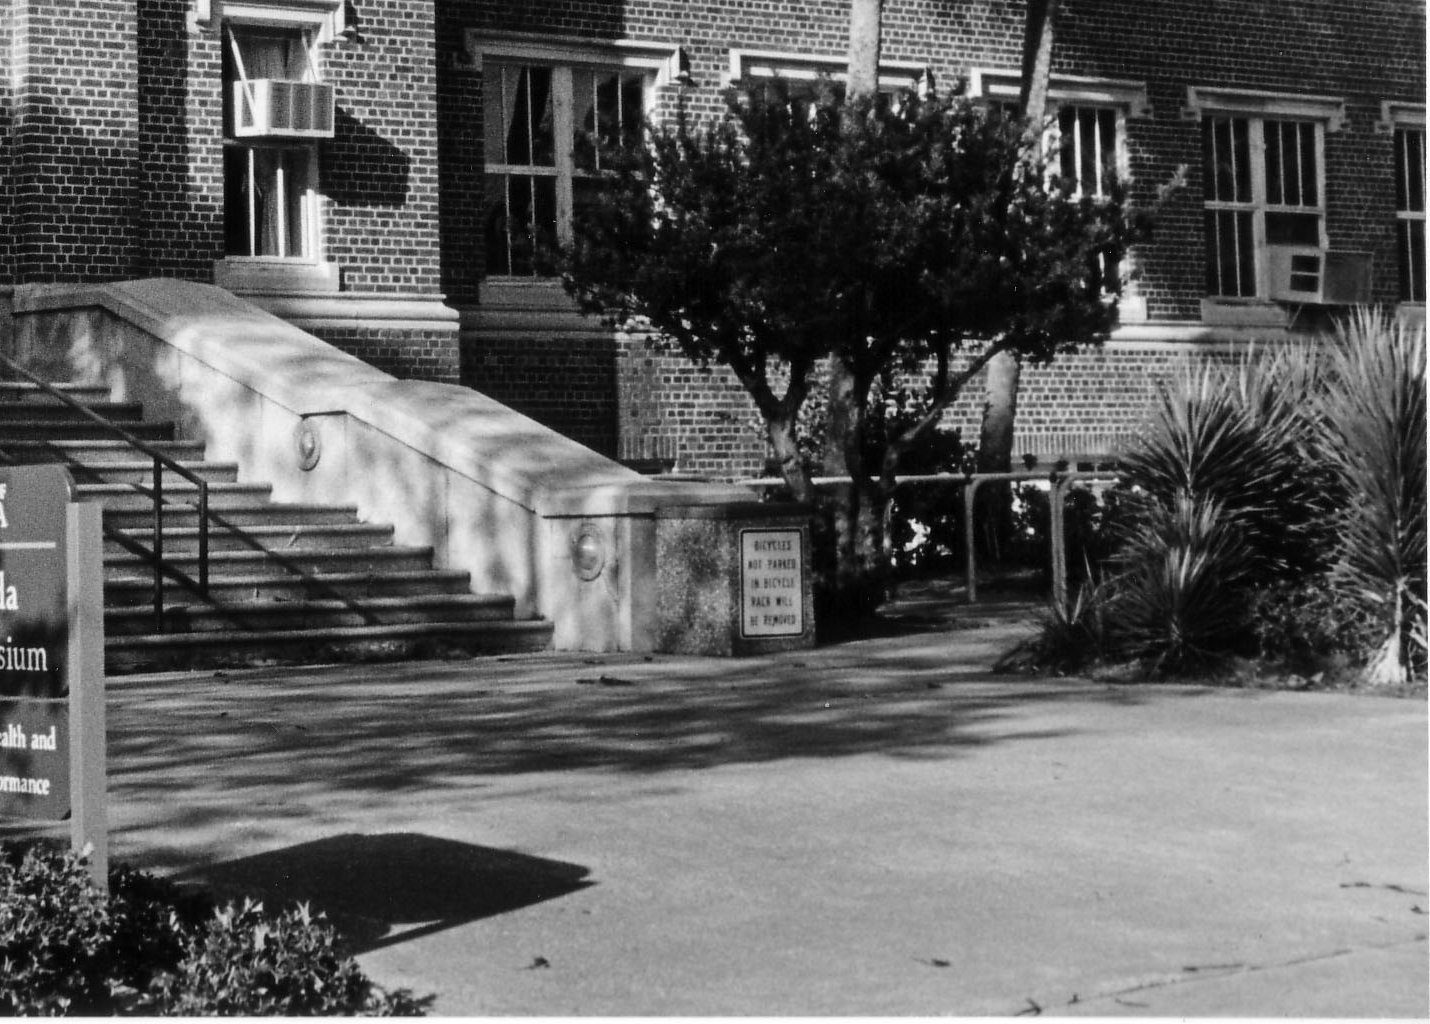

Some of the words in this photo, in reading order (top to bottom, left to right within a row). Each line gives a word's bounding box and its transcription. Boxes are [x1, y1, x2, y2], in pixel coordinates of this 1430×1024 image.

[754, 540, 792, 551] BICYCLES
[748, 559, 762, 570] NOT
[767, 558, 796, 570] PARKED
[751, 577, 759, 589] IN
[763, 577, 794, 589] BICYCLE
[751, 596, 770, 607] RACK
[750, 615, 758, 626] BE
[763, 614, 796, 625] REMOVED
[31, 726, 56, 751] and
